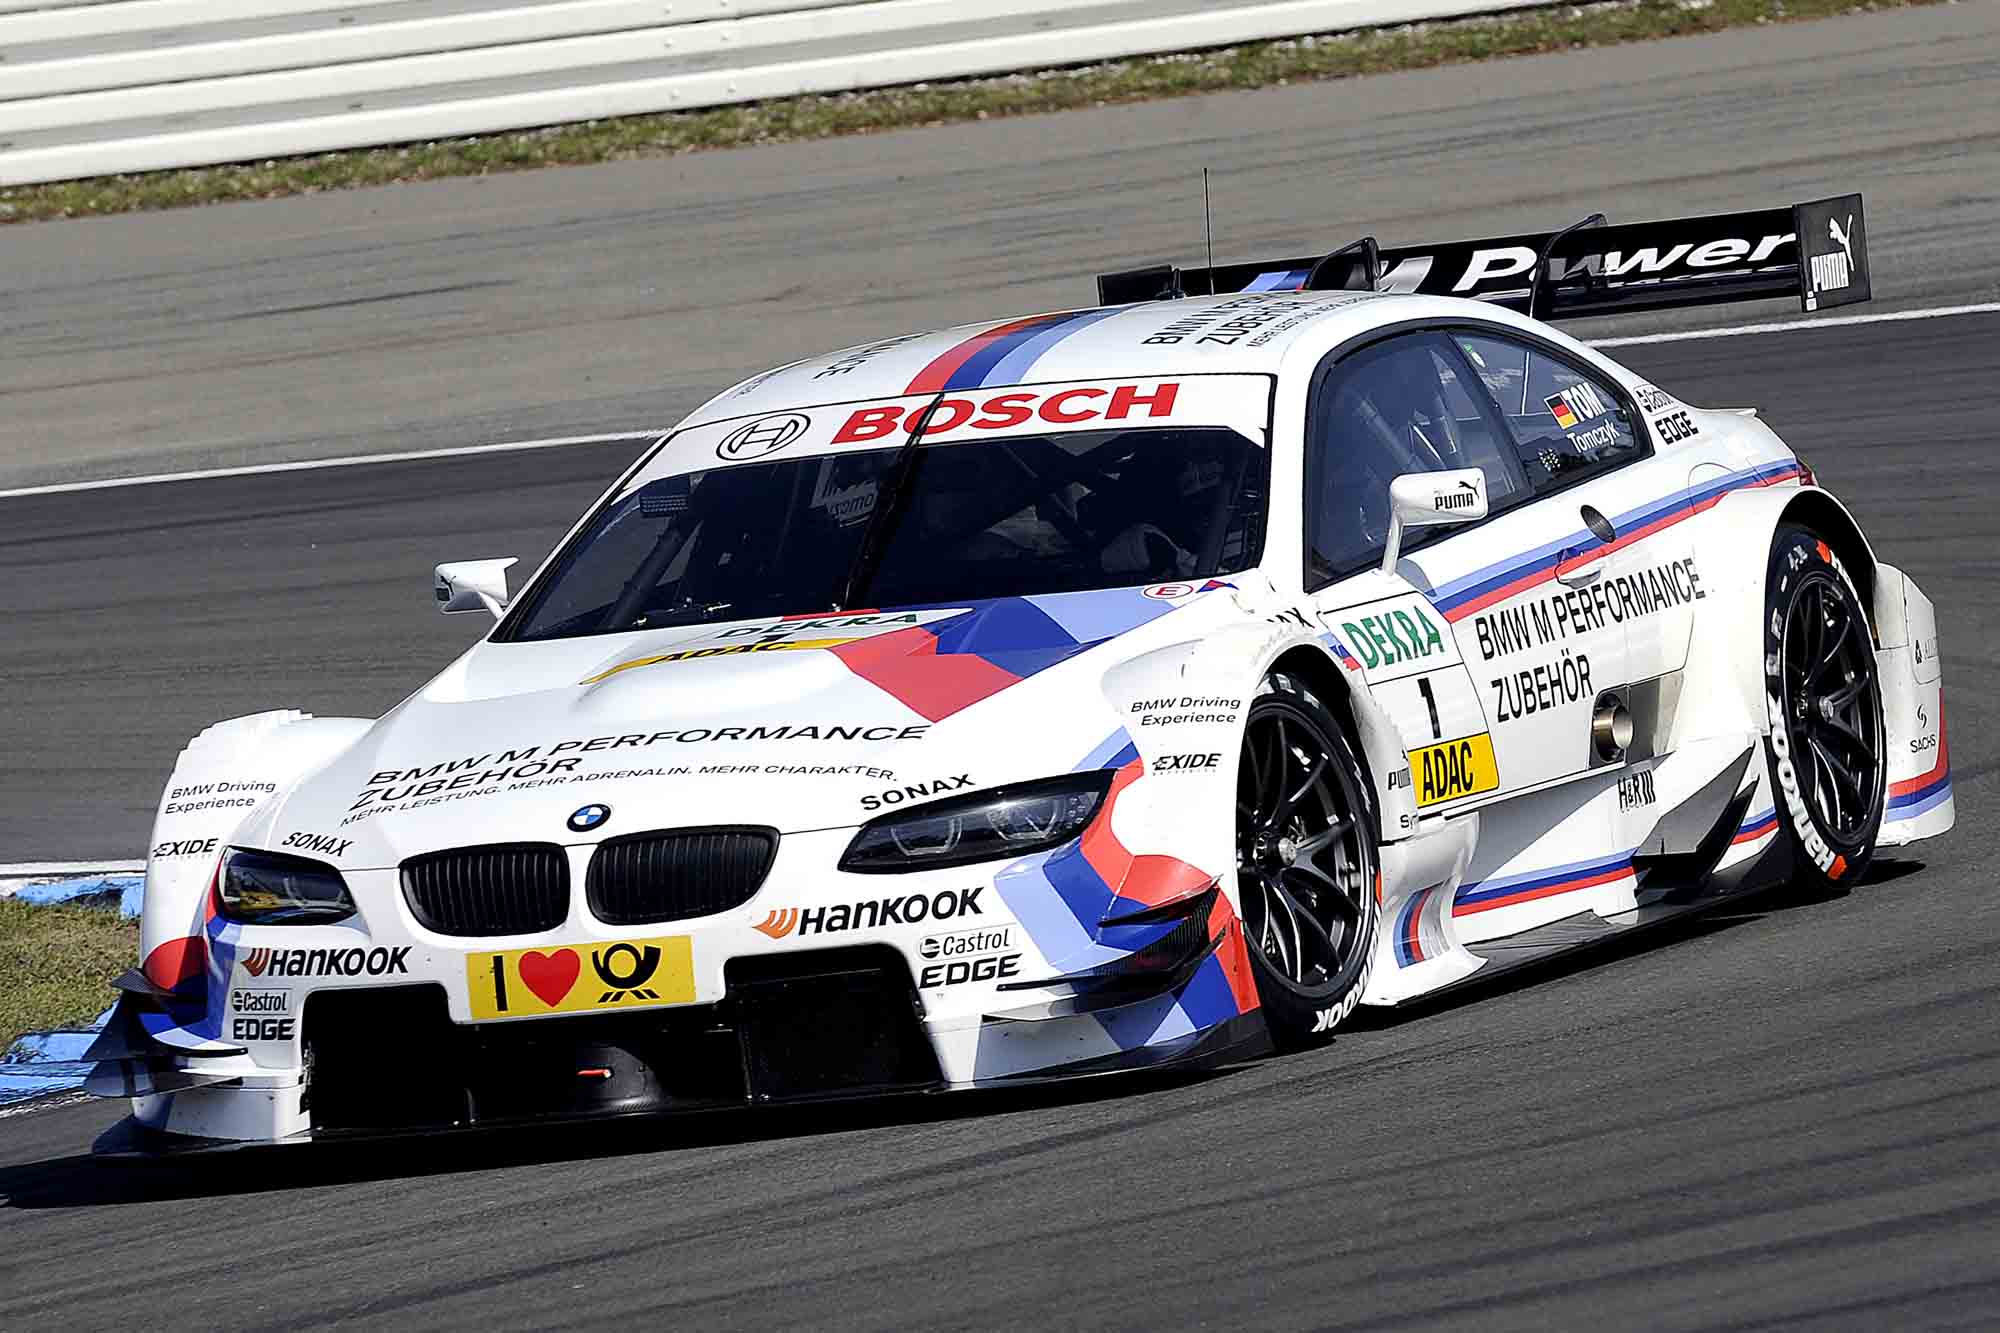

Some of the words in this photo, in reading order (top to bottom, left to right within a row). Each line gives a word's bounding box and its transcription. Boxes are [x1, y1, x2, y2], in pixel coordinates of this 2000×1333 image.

[1451, 233, 1797, 292] Pwer
[1811, 252, 1849, 292] PUMA
[830, 383, 1180, 445] BOSCH
[1559, 382, 1606, 422] TOM
[1567, 419, 1620, 454] Tomczyk
[1654, 410, 1699, 445] EDGE
[1435, 493, 1474, 511] PUMA
[715, 613, 917, 640] DEKRA
[1475, 604, 1531, 661] BMW
[1530, 599, 1556, 645] M
[1552, 558, 1706, 639] PERFORMANCE
[1341, 605, 1445, 669] DEKRA
[1491, 648, 1594, 723] ZUBEHÖR
[1131, 698, 1177, 712] BMW
[1179, 696, 1241, 710] Driving
[1141, 712, 1237, 727] Experience
[1417, 677, 1441, 739] 1
[366, 754, 491, 786] BMW
[496, 746, 541, 764] M
[549, 725, 932, 757] PERFORMANCE
[1152, 753, 1222, 771] EXIDE
[1422, 741, 1474, 802] ADAC
[170, 784, 215, 800] BMW
[217, 782, 276, 794] Driving
[340, 804, 396, 827] MEHR
[399, 785, 501, 811] LEISTUNG.
[508, 776, 567, 791] MEHR
[570, 767, 692, 783] ADRENALIN.
[699, 765, 759, 775] MEHR
[764, 764, 898, 782] CHARAKTER.
[349, 758, 583, 811] ZUBEHÖR
[860, 774, 975, 811] SONAX
[165, 797, 255, 815] Experience
[153, 838, 219, 858] EXIDE
[282, 832, 353, 857] SONAX
[942, 928, 1010, 956] Castrol
[493, 955, 508, 1012] I
[919, 953, 1022, 989] EDGE
[243, 991, 287, 1012] Castrol
[233, 1018, 296, 1041] EDGE
